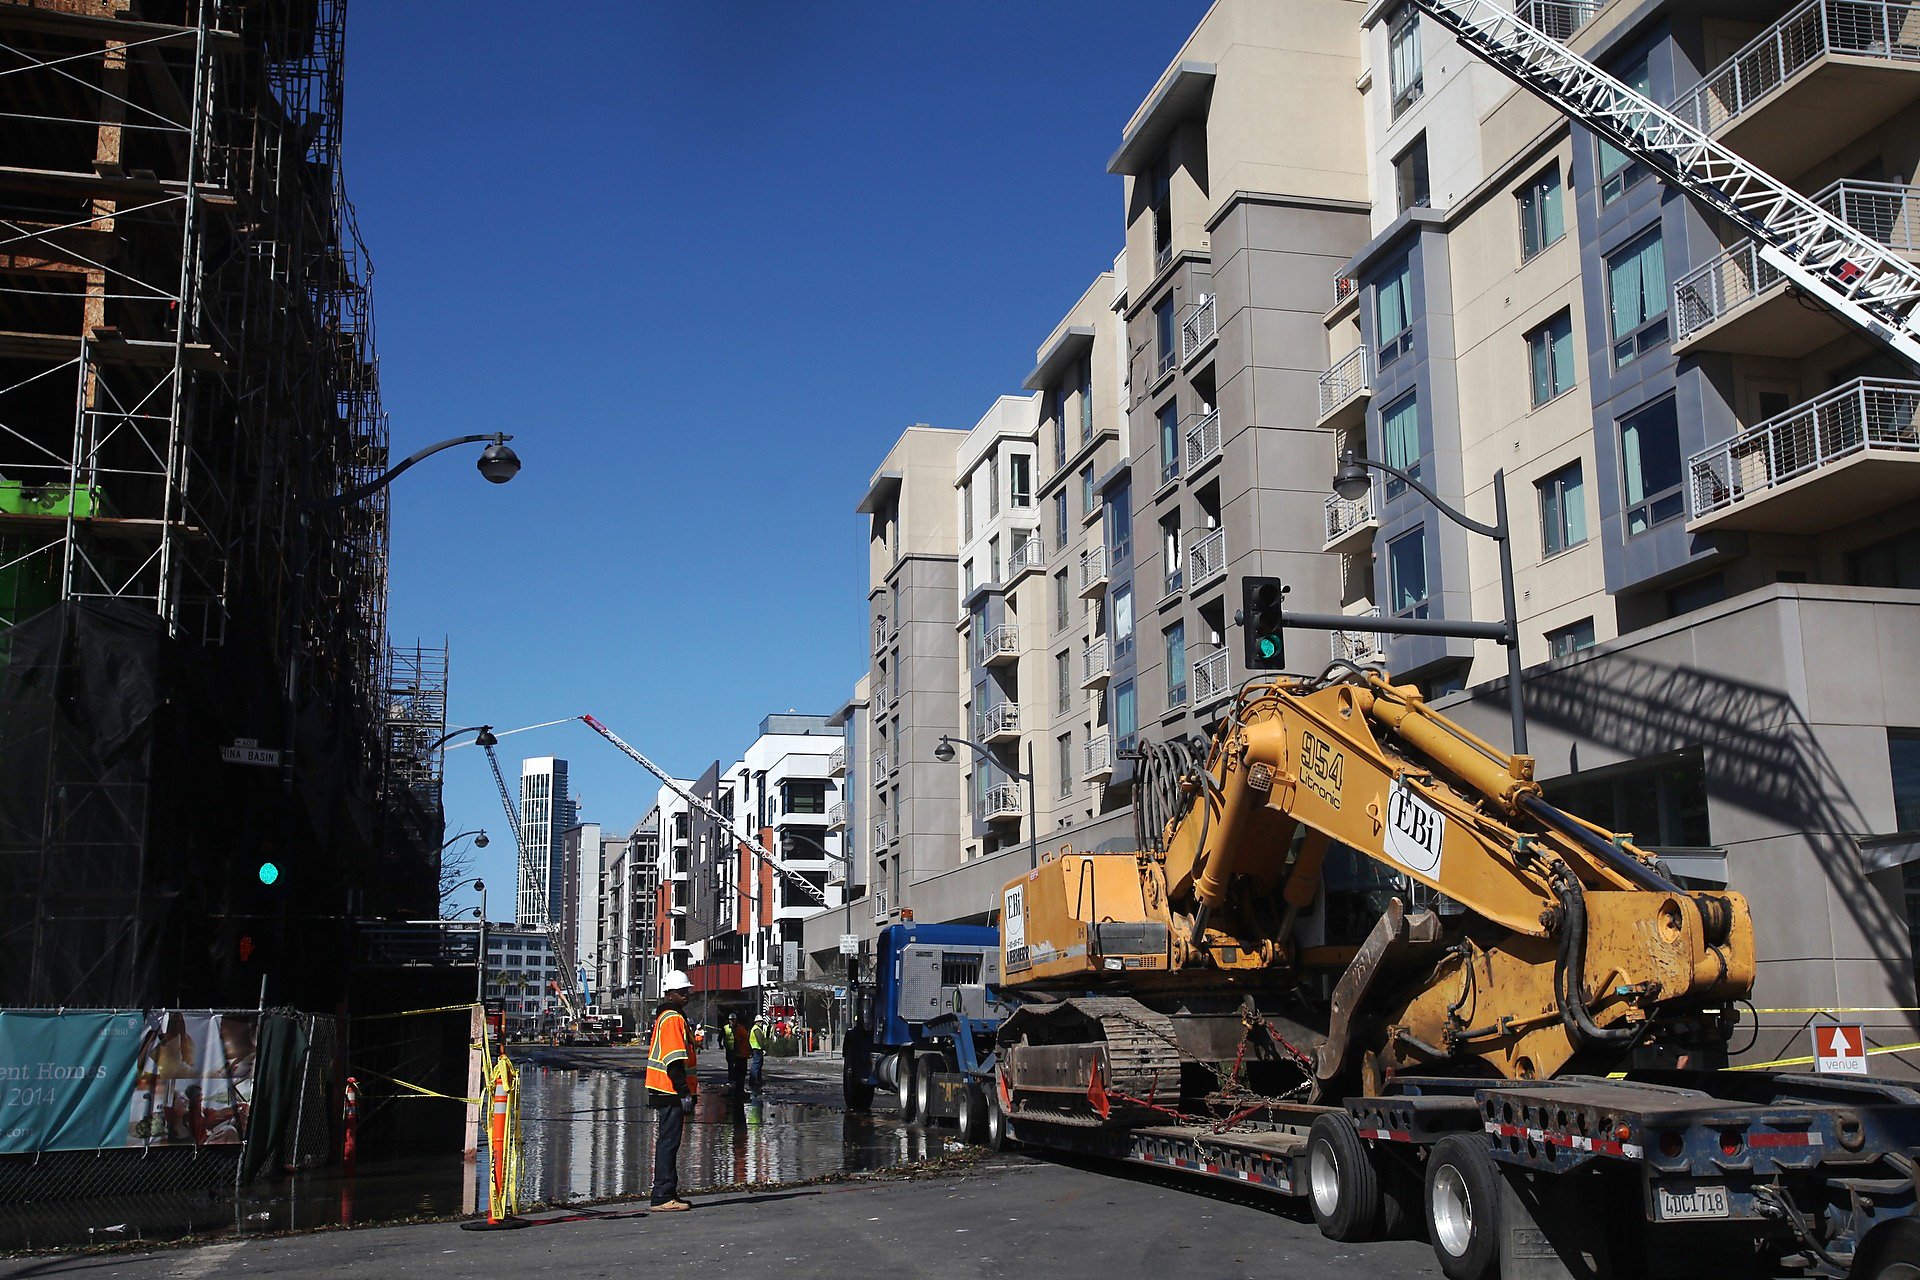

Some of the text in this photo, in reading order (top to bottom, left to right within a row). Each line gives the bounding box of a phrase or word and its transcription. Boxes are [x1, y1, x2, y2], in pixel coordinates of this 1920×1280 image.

[248, 750, 274, 763] BASIN
[1300, 730, 1345, 792] 954
[1299, 766, 1341, 811] Litronic
[1825, 1060, 1859, 1070] venue
[8, 1087, 56, 1107] 2014
[1665, 1193, 1724, 1214] 4DC1718
